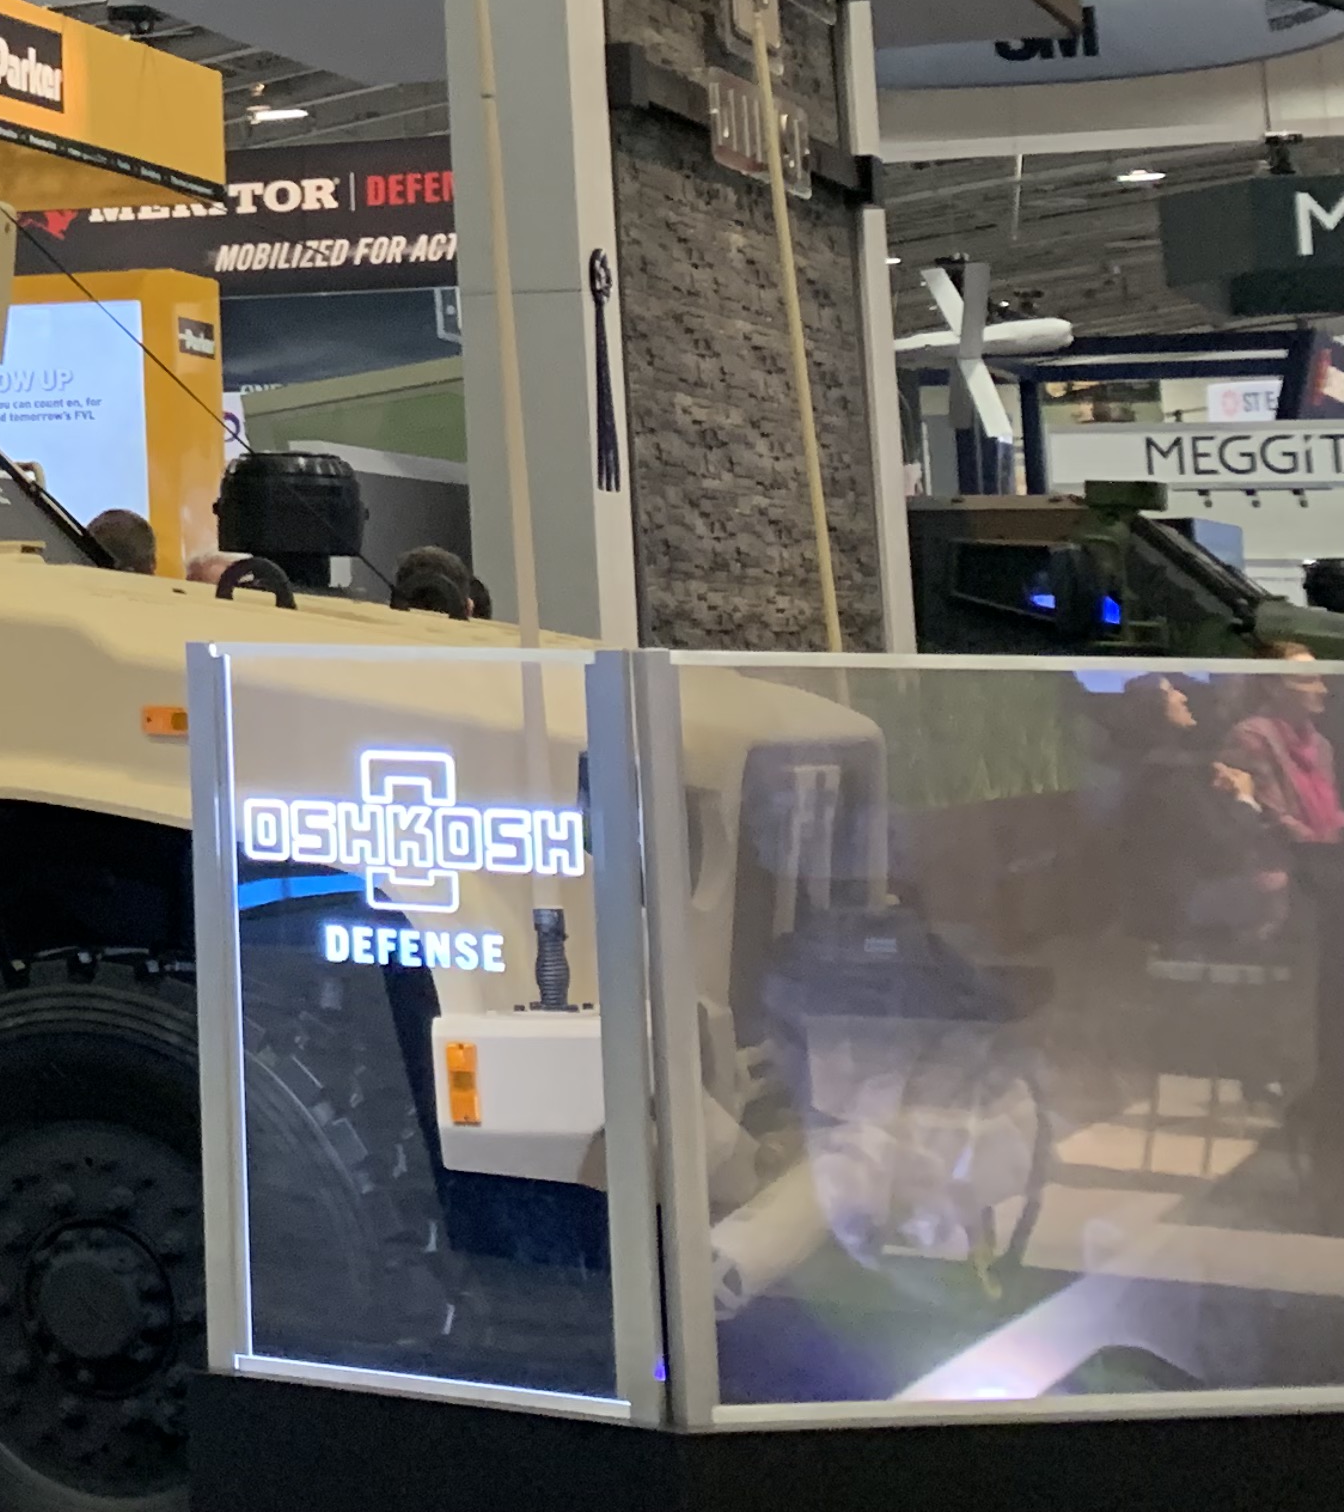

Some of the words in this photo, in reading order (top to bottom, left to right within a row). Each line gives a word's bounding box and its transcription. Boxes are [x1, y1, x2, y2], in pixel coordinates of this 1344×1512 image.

[214, 238, 350, 273] MOBILIZED
[353, 235, 406, 266] FOR
[41, 367, 74, 393] UP
[243, 797, 585, 877] OSHKOSH
[323, 923, 506, 973] DEFENSE
